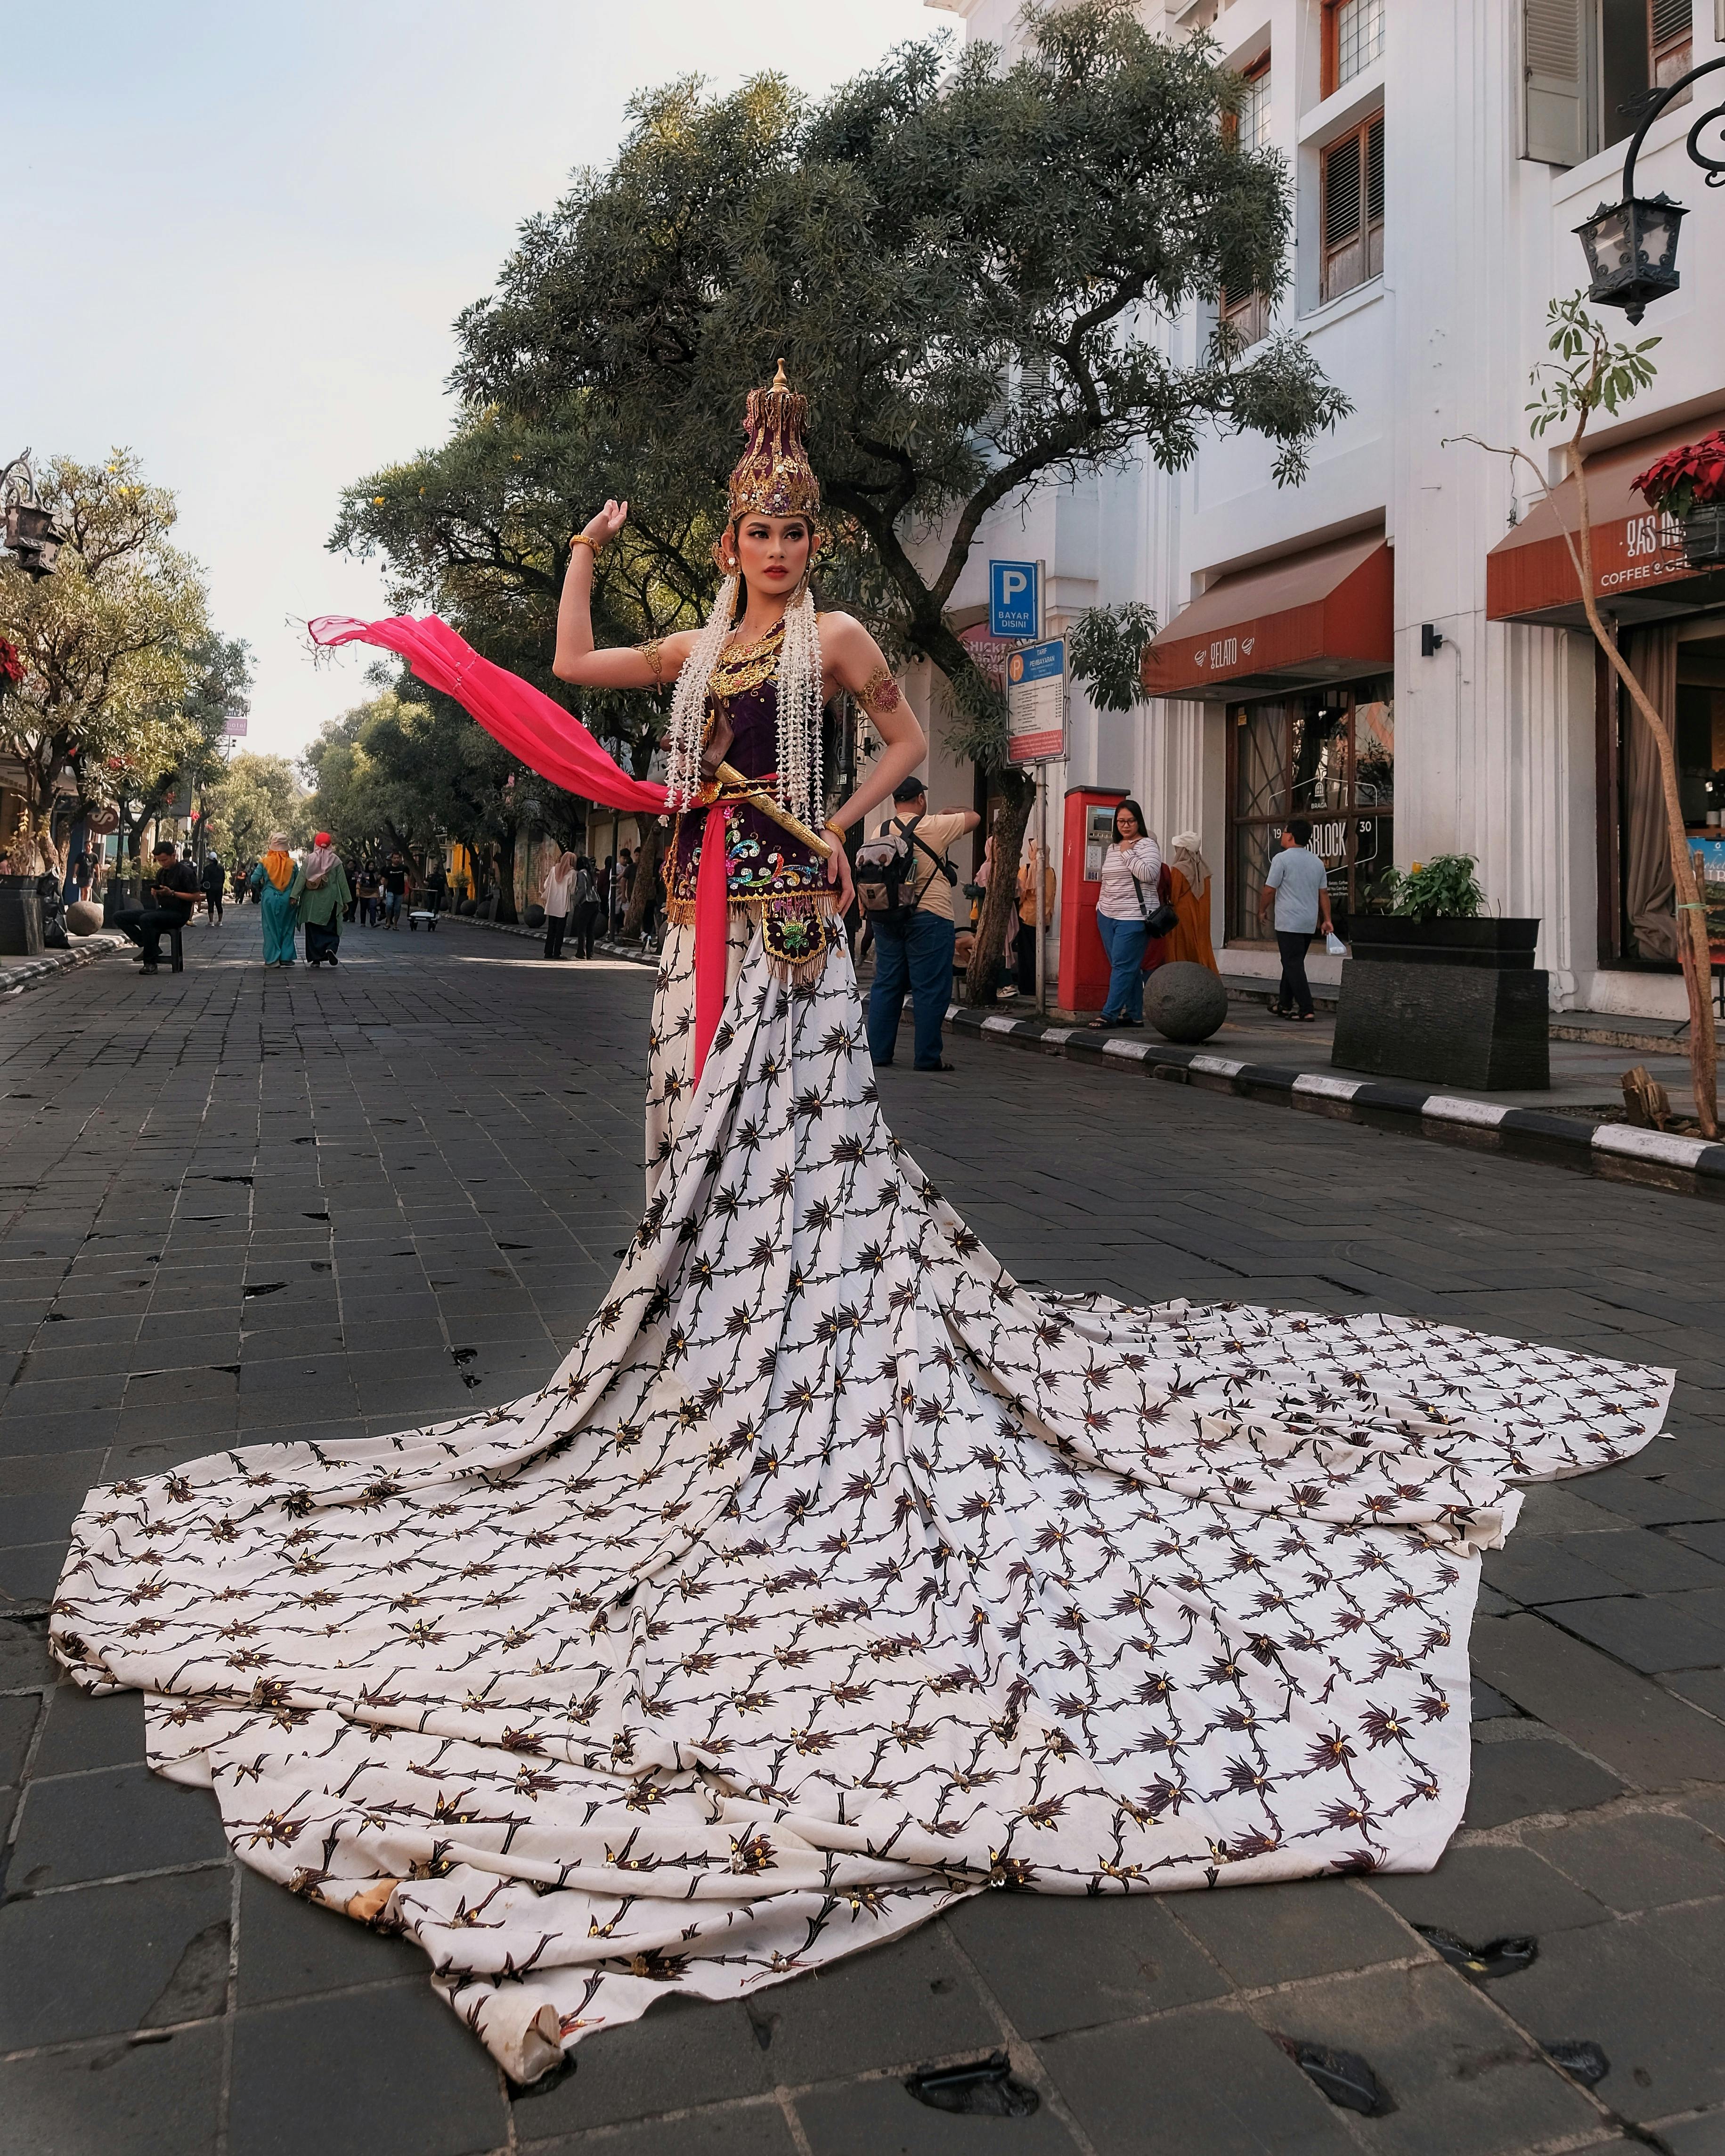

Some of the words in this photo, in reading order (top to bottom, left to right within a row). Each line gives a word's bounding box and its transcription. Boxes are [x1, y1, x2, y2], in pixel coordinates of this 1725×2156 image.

[1601, 565, 1651, 586] COFFEE
[1003, 570, 1027, 604] P
[998, 611, 1029, 620] BAYAR
[1001, 620, 1026, 628] DISINI
[1037, 648, 1047, 656] TARIF
[1029, 655, 1055, 667] PEMBAYARAN
[1273, 829, 1281, 838] 19
[1359, 821, 1372, 832] 30
[1088, 872, 1098, 880] 094
